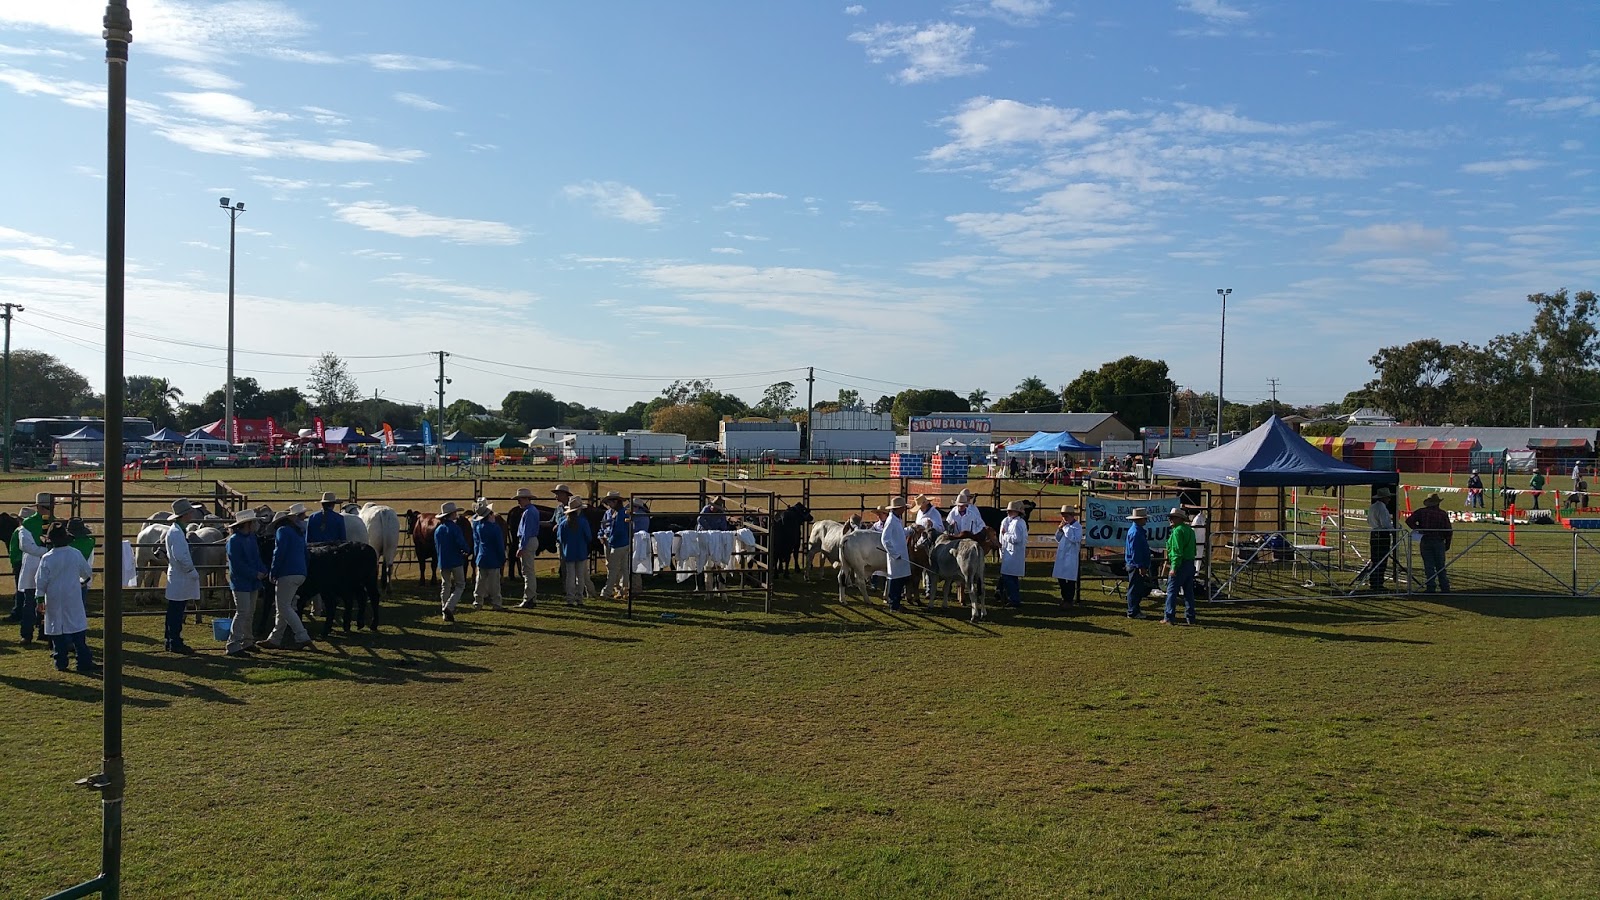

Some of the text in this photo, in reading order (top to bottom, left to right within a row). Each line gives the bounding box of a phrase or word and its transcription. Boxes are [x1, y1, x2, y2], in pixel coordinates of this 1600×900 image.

[912, 419, 989, 432] SHOWBAGLAND
[1089, 525, 1113, 540] GO
[1145, 527, 1172, 540] LUE
